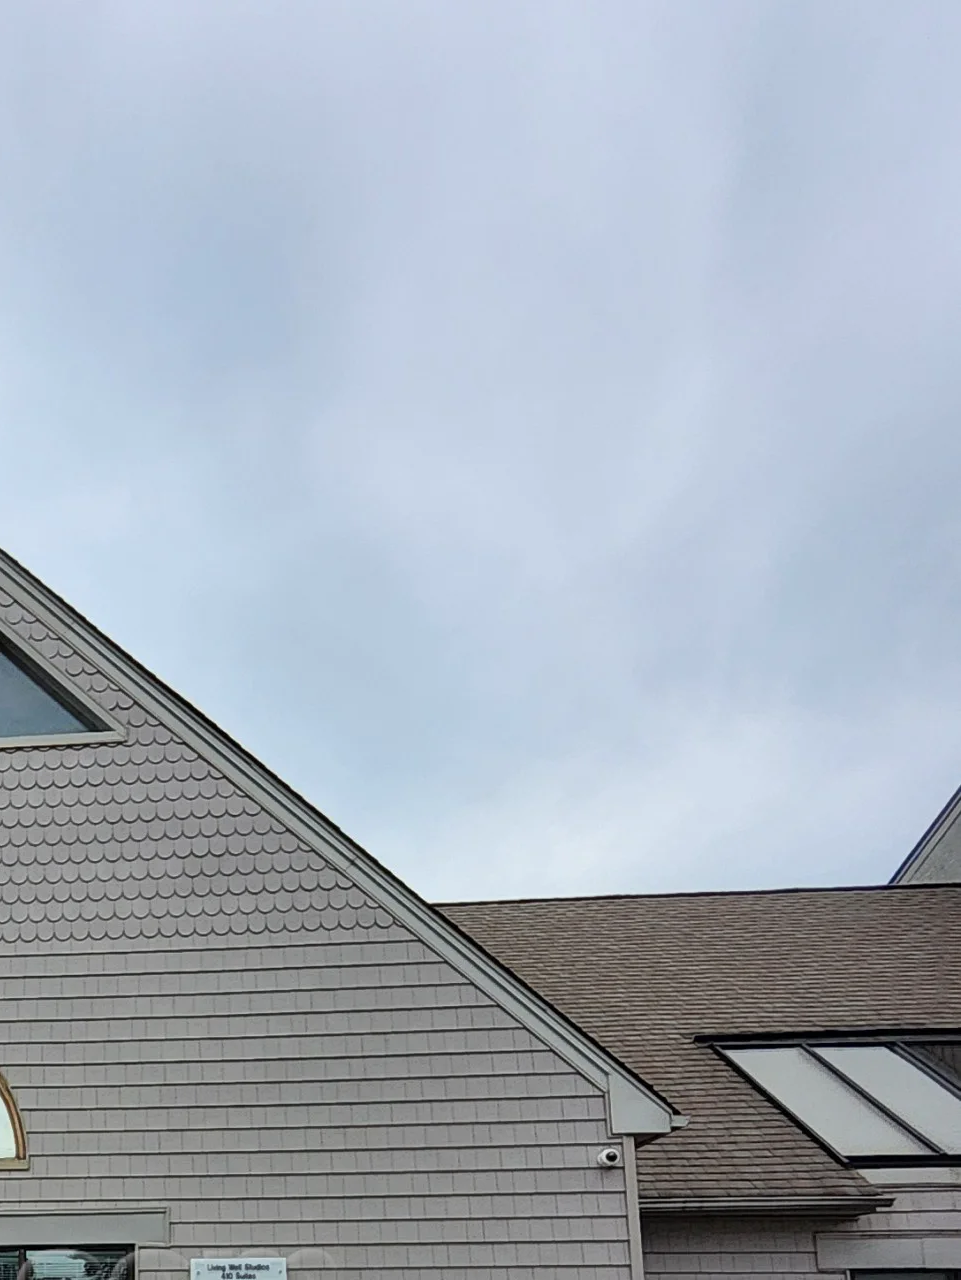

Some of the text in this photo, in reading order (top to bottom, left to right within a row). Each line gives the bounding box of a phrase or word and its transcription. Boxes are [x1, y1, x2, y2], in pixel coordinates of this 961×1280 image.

[207, 1263, 226, 1272] Living
[244, 1263, 270, 1271] Studios
[221, 1271, 256, 1279] 410 Suites
